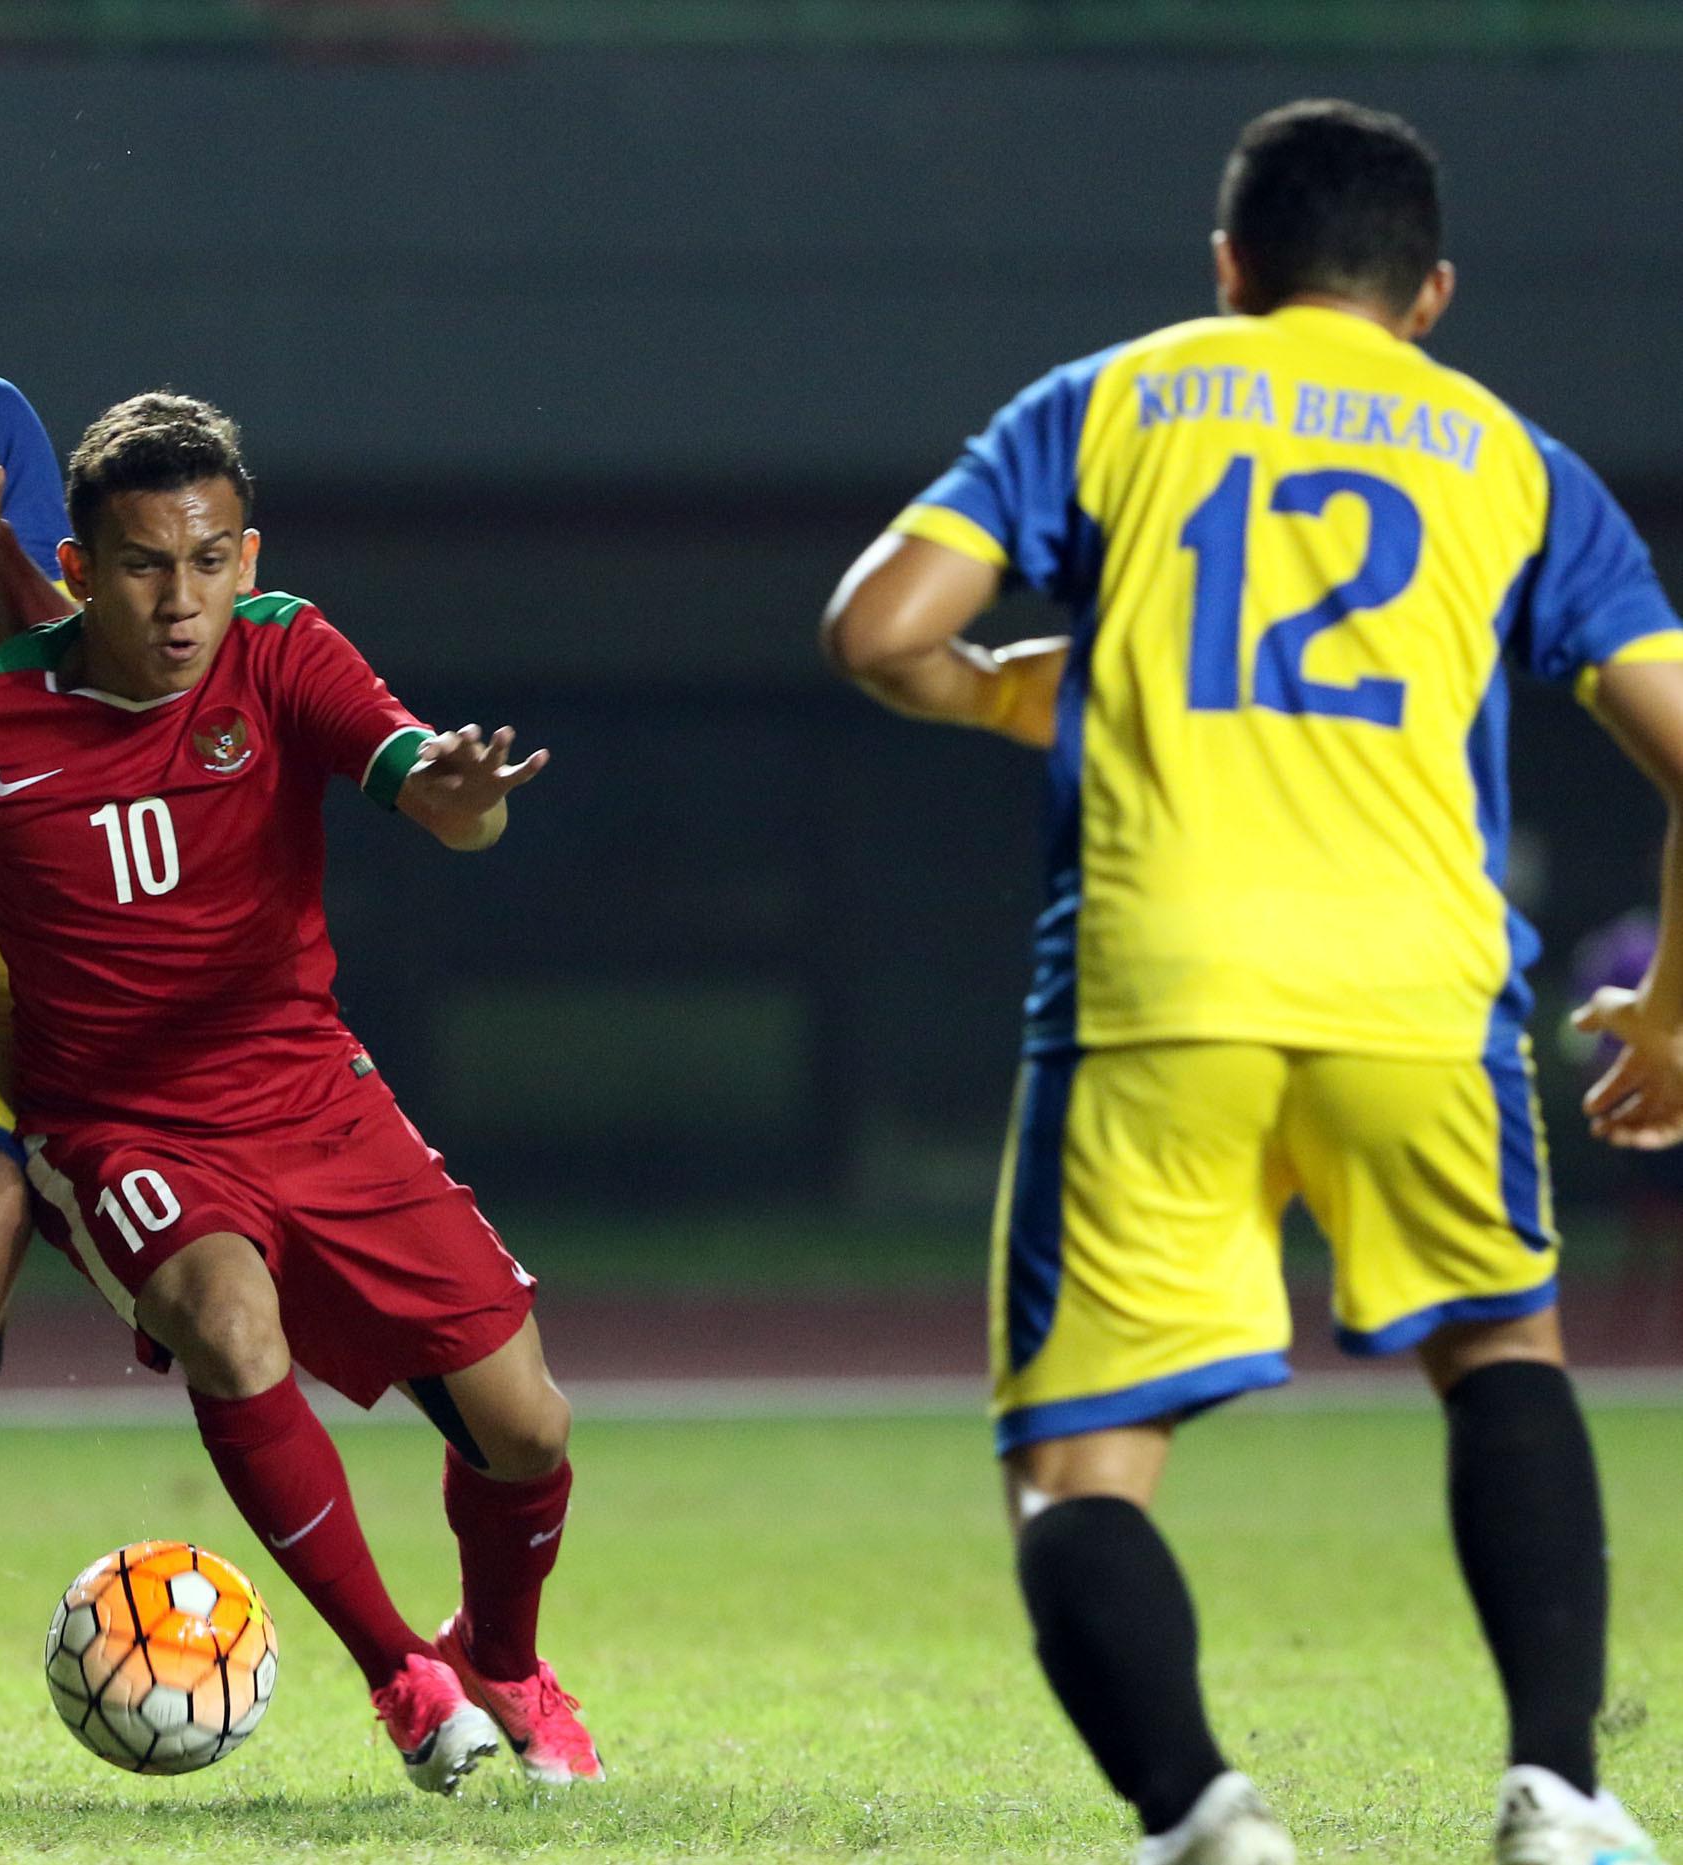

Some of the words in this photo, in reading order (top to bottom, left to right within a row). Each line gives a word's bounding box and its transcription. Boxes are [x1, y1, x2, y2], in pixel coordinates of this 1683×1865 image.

[1135, 365, 1274, 428] KOTA
[1292, 381, 1482, 470] BEKASI
[1179, 455, 1424, 729] 12
[89, 797, 180, 904] 10
[94, 1168, 182, 1254] 10
